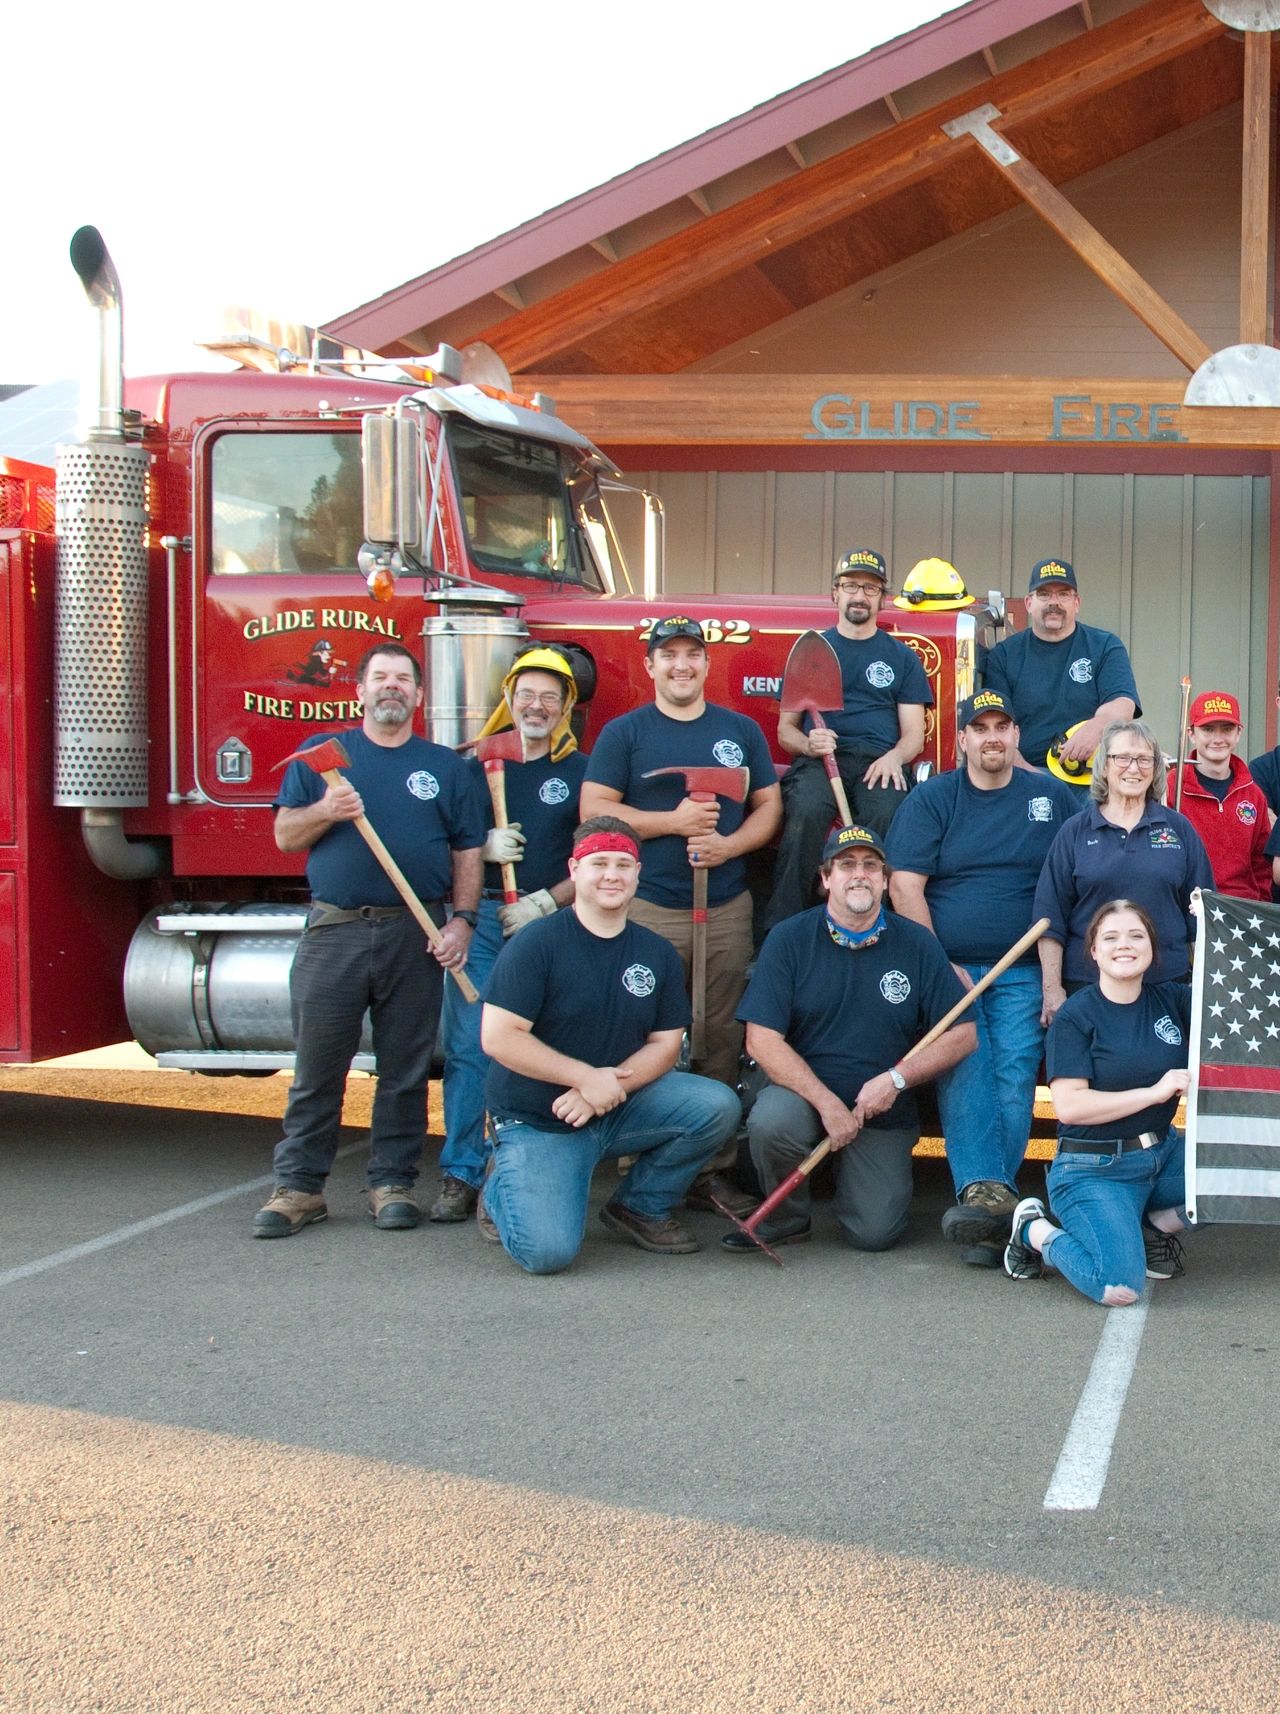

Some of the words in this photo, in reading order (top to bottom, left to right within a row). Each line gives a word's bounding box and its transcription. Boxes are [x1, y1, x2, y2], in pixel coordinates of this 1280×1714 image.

[805, 393, 990, 440] GLIDE
[1048, 395, 1188, 442] FIRE
[1041, 563, 1065, 574] Glide
[243, 609, 315, 640] GLIDE
[321, 608, 402, 640] RURAL
[639, 617, 751, 644] 262
[743, 676, 783, 693] KEN
[243, 690, 295, 719] FIRE
[299, 699, 364, 721] DISTR
[974, 692, 1003, 706] Glide
[1205, 698, 1232, 709] Glide
[839, 828, 872, 840] Glide
